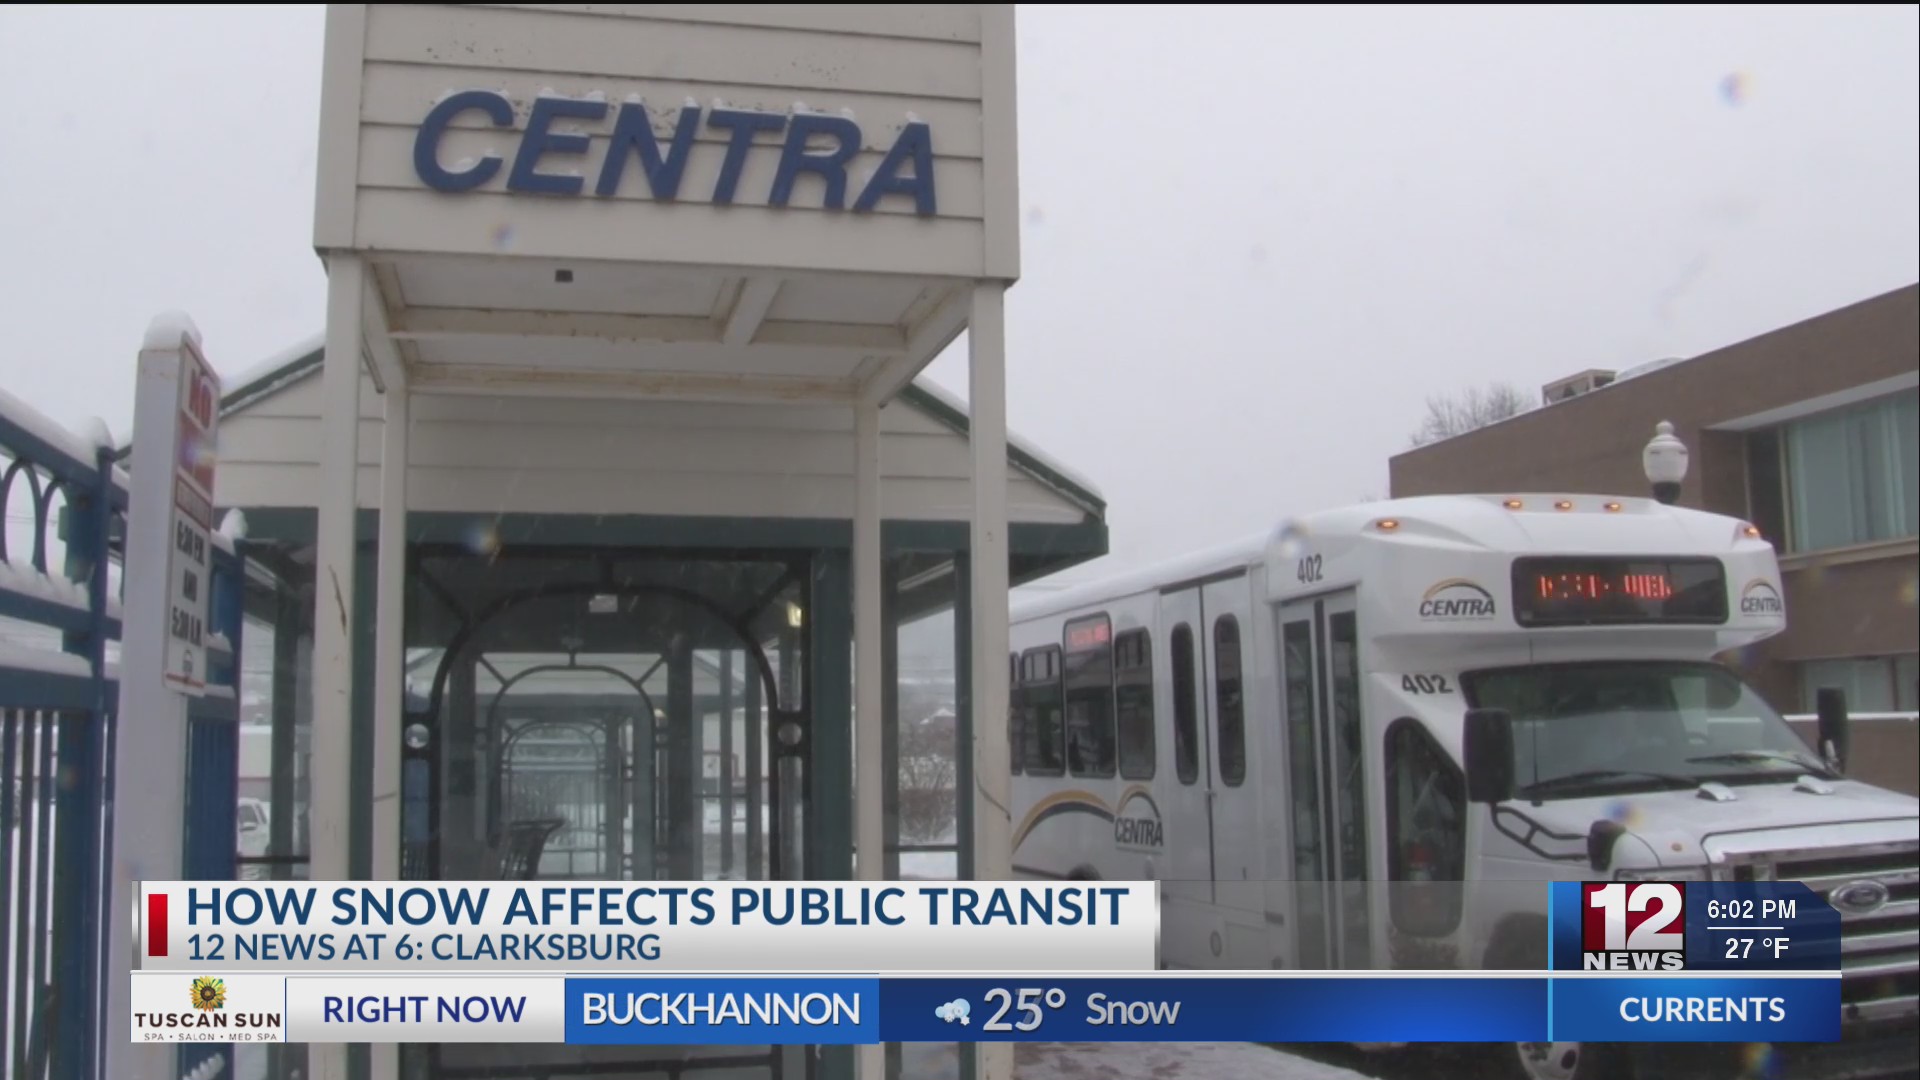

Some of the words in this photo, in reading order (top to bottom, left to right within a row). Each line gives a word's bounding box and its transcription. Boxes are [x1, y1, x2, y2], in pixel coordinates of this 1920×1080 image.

[413, 90, 937, 217] CENTRA
[1297, 553, 1323, 584] 402
[1419, 599, 1495, 617] CENTRA
[1741, 597, 1783, 612] CENTRA
[1402, 674, 1454, 695] 402
[1114, 817, 1164, 847] CENTRA
